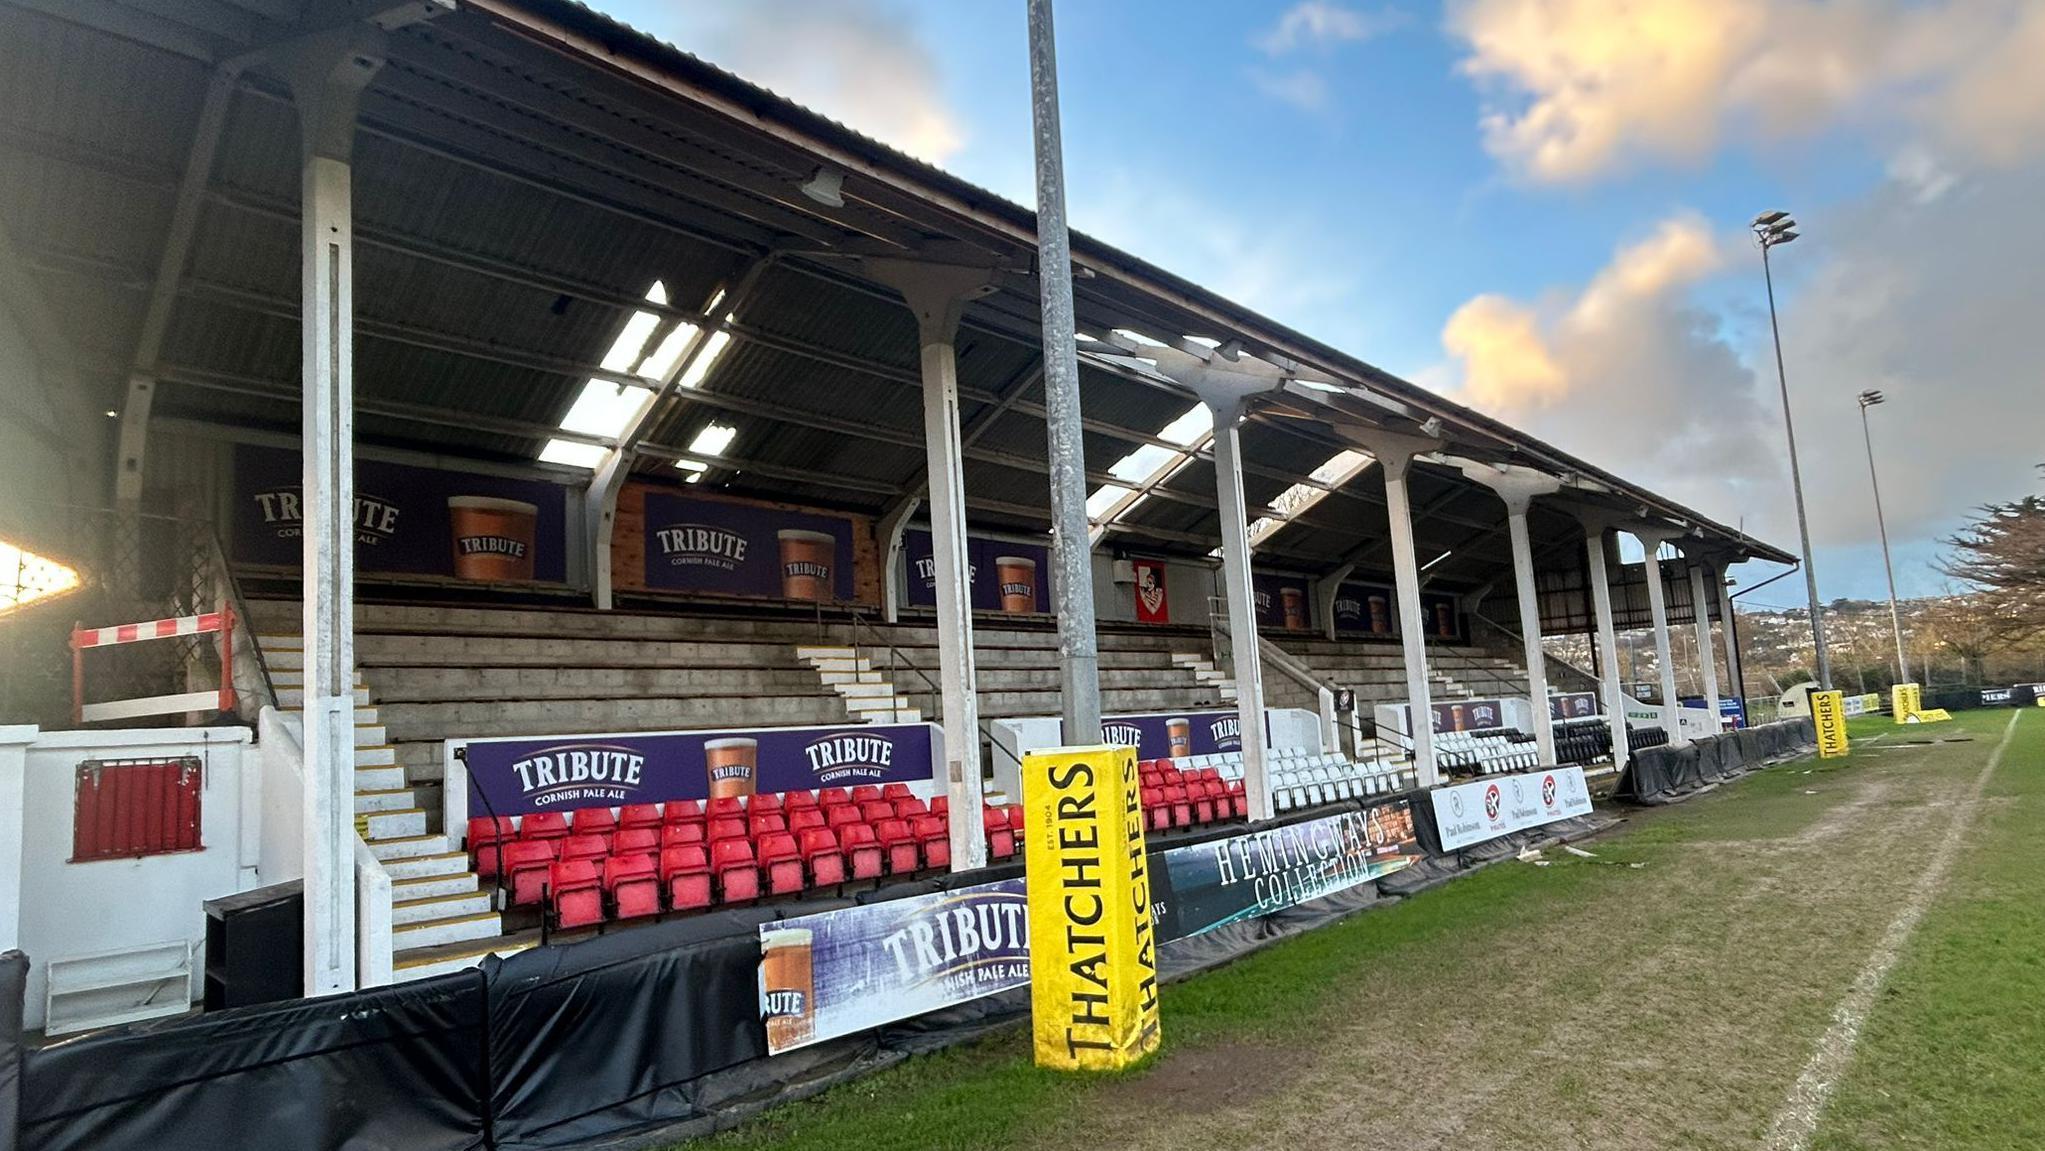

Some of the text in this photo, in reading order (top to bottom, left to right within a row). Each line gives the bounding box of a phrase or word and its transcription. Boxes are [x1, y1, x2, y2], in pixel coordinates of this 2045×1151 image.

[254, 492, 400, 534] TRTE
[461, 537, 525, 557] TRIBUTE
[656, 528, 748, 562] TRIBUTE
[671, 557, 735, 571] CORNISH PALE ALE
[786, 562, 828, 579] TRIBUTE
[1002, 584, 1031, 597] TRIBUTE
[1210, 718, 1241, 741] TRIBU
[1816, 693, 1838, 756] THATCHERS
[1101, 725, 1142, 748] IBUTE
[805, 738, 893, 771] TRIBUTE
[513, 751, 644, 793] TRIBUTE
[712, 765, 751, 780] TRIBUTE
[820, 768, 881, 783] CORNISH PALE ALE
[535, 788, 625, 806] CORNISH PALE ALE
[1045, 804, 1053, 828] 1904
[1215, 807, 1385, 886] HEMINGWAYS
[1254, 850, 1370, 910] COLLECTION
[1048, 763, 1113, 1059] THATCHERS
[1122, 757, 1157, 1050] THATCHERS
[978, 964, 1005, 982] PALE
[1008, 963, 1029, 978] ALE
